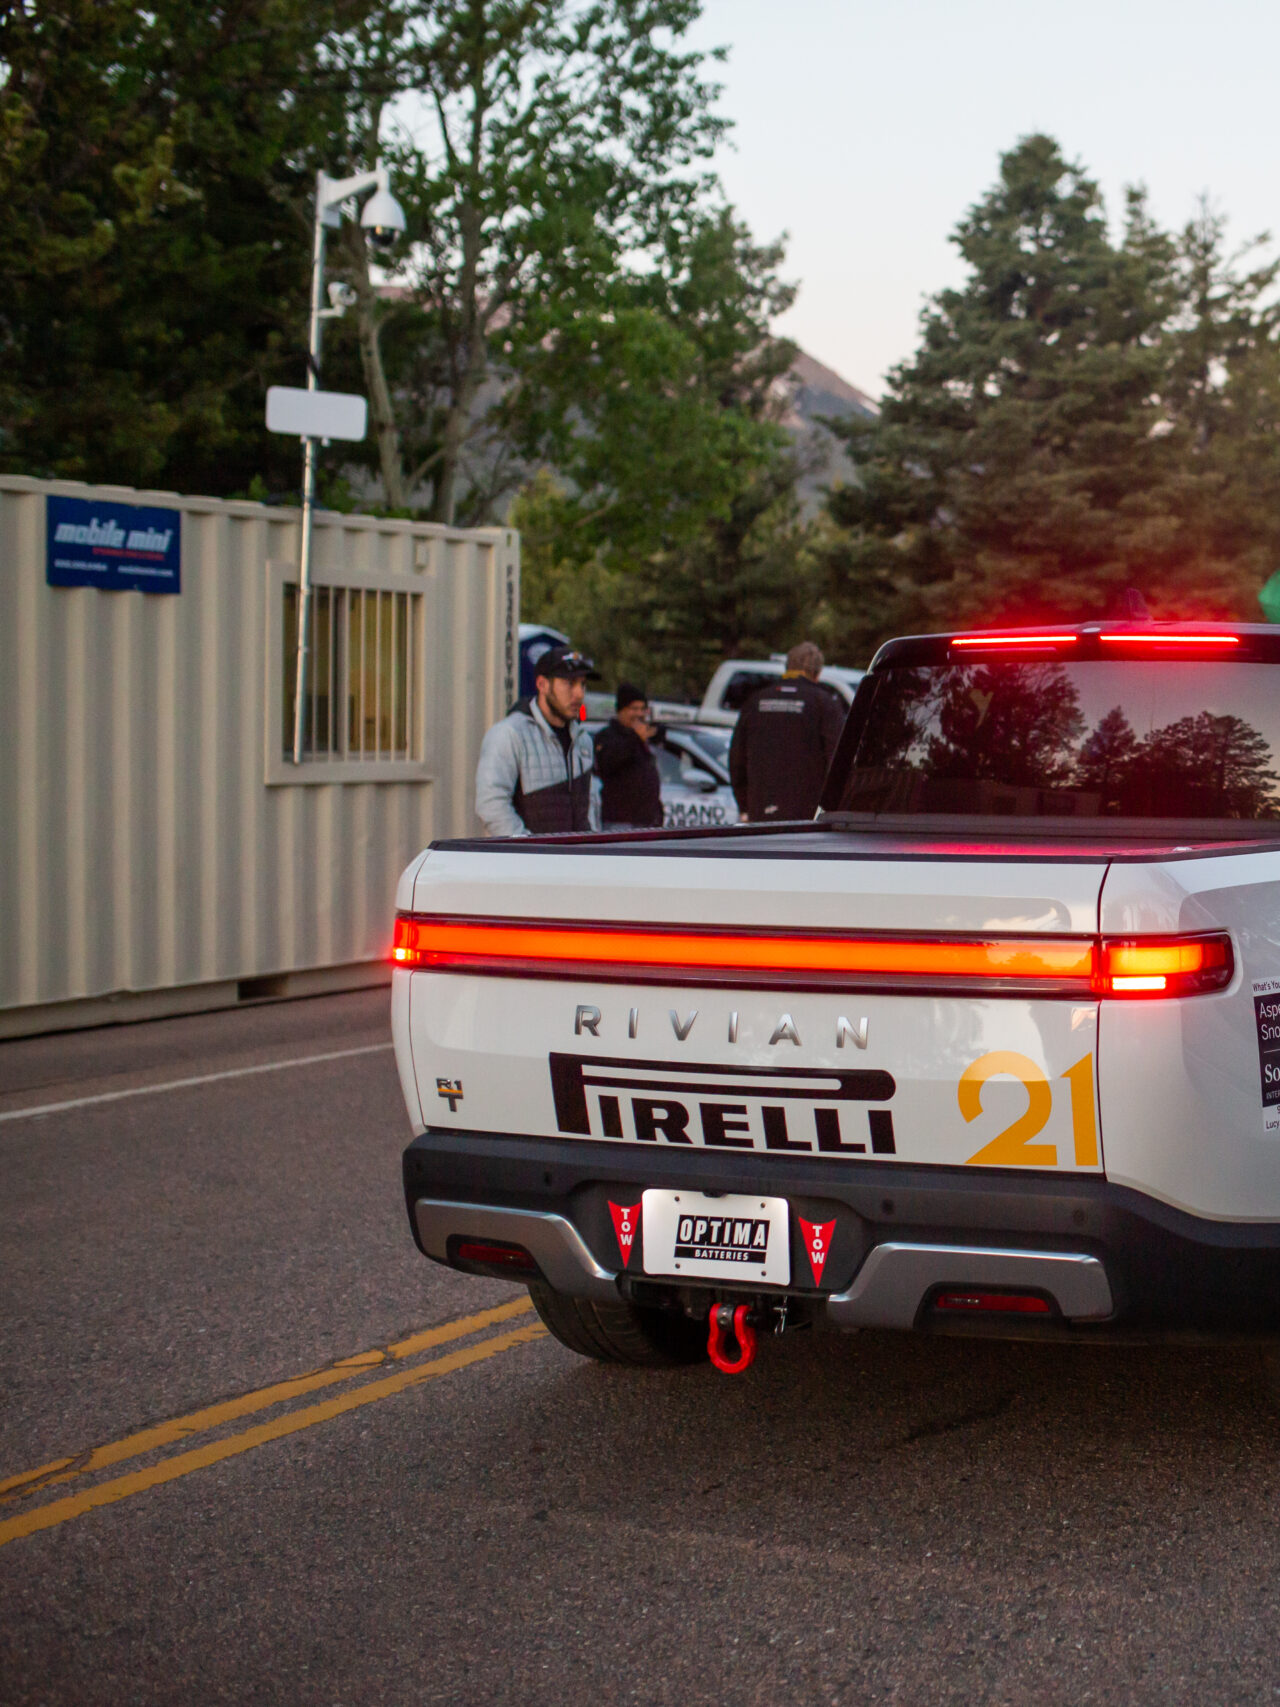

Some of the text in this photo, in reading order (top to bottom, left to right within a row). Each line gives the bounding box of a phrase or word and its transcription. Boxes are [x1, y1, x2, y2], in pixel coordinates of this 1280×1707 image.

[54, 517, 174, 553] mobile mini
[1252, 981, 1271, 992] What's
[574, 1004, 869, 1050] RIVIAN
[549, 1051, 896, 1154] PIRELLI
[957, 1050, 1099, 1167] 21
[620, 1208, 632, 1246] TOW
[679, 1218, 767, 1247] OPTIMA
[812, 1225, 825, 1264] TOW
[694, 1249, 749, 1261] BATTERIES
